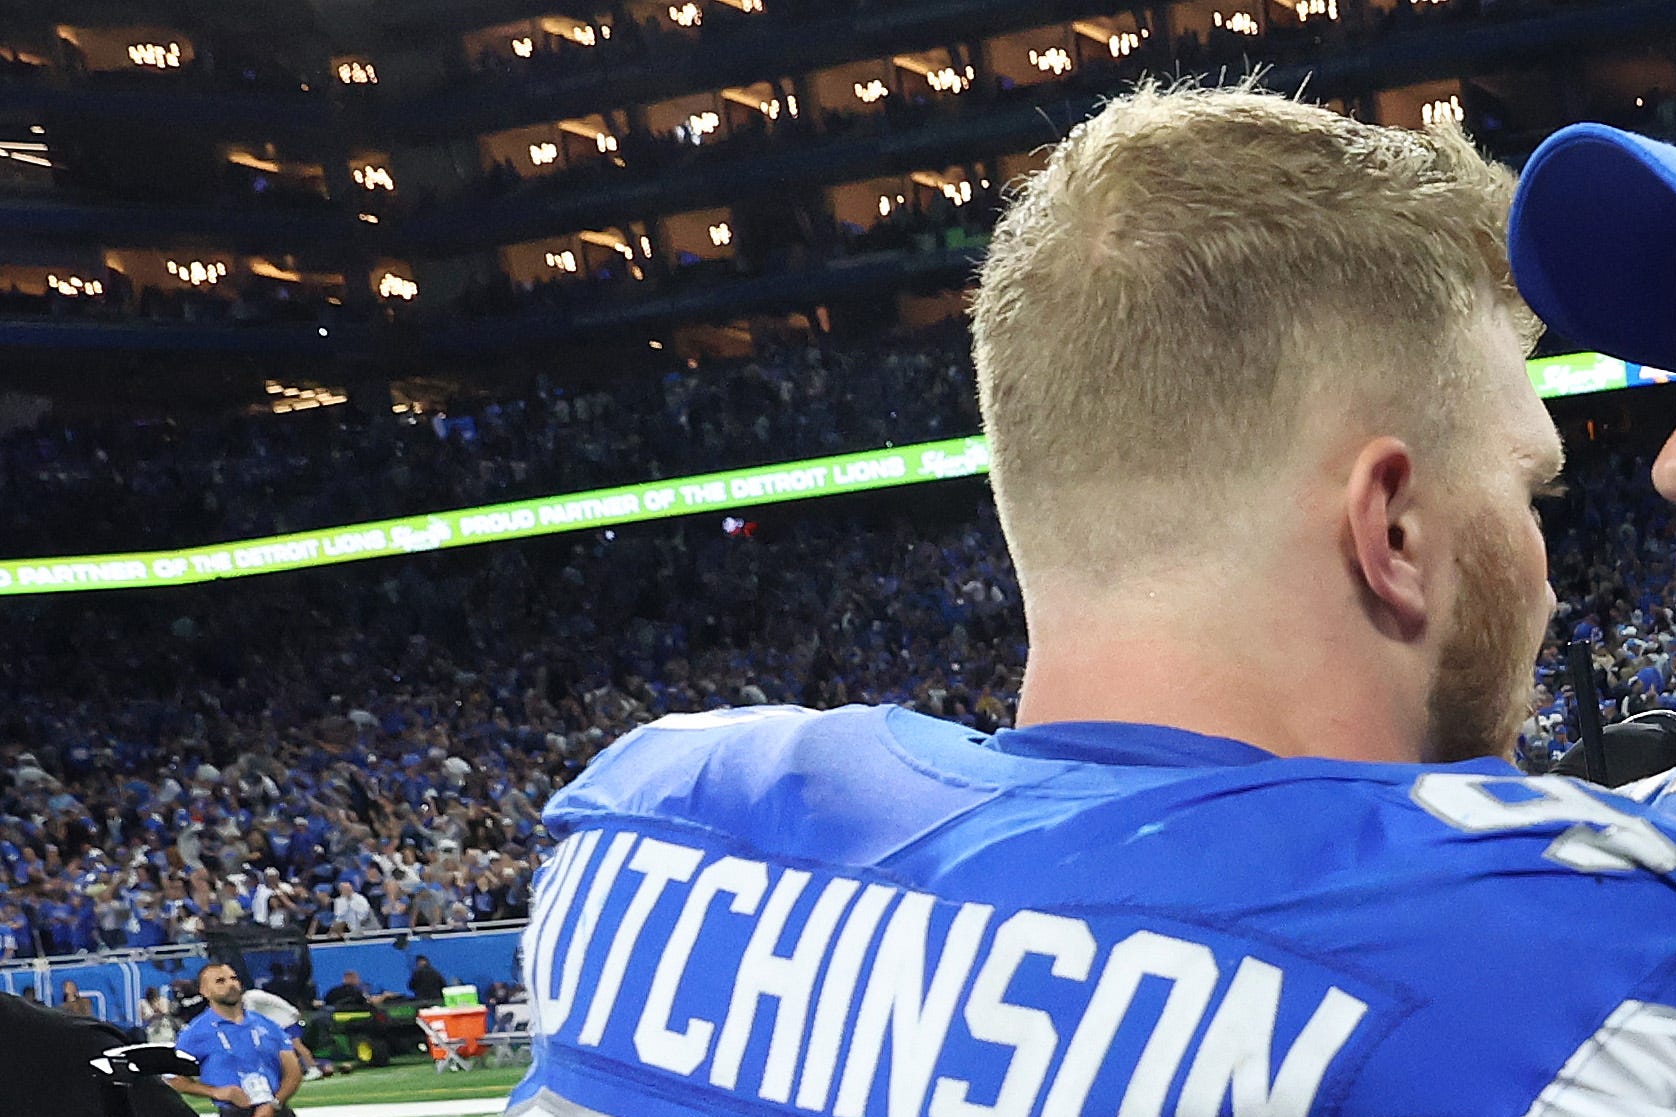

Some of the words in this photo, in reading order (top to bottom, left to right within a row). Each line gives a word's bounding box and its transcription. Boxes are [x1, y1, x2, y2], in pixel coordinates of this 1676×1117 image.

[460, 509, 535, 536] PROUD
[538, 494, 640, 525] PARTNER
[643, 488, 675, 512] OF
[680, 481, 727, 505] THE
[730, 467, 828, 499] DETROIT
[833, 456, 906, 485] LIONS
[17, 560, 147, 585] PARTNER
[152, 558, 189, 578] OF
[190, 552, 232, 573] THE
[234, 539, 320, 568] DETROIT
[322, 529, 386, 556] LIONS
